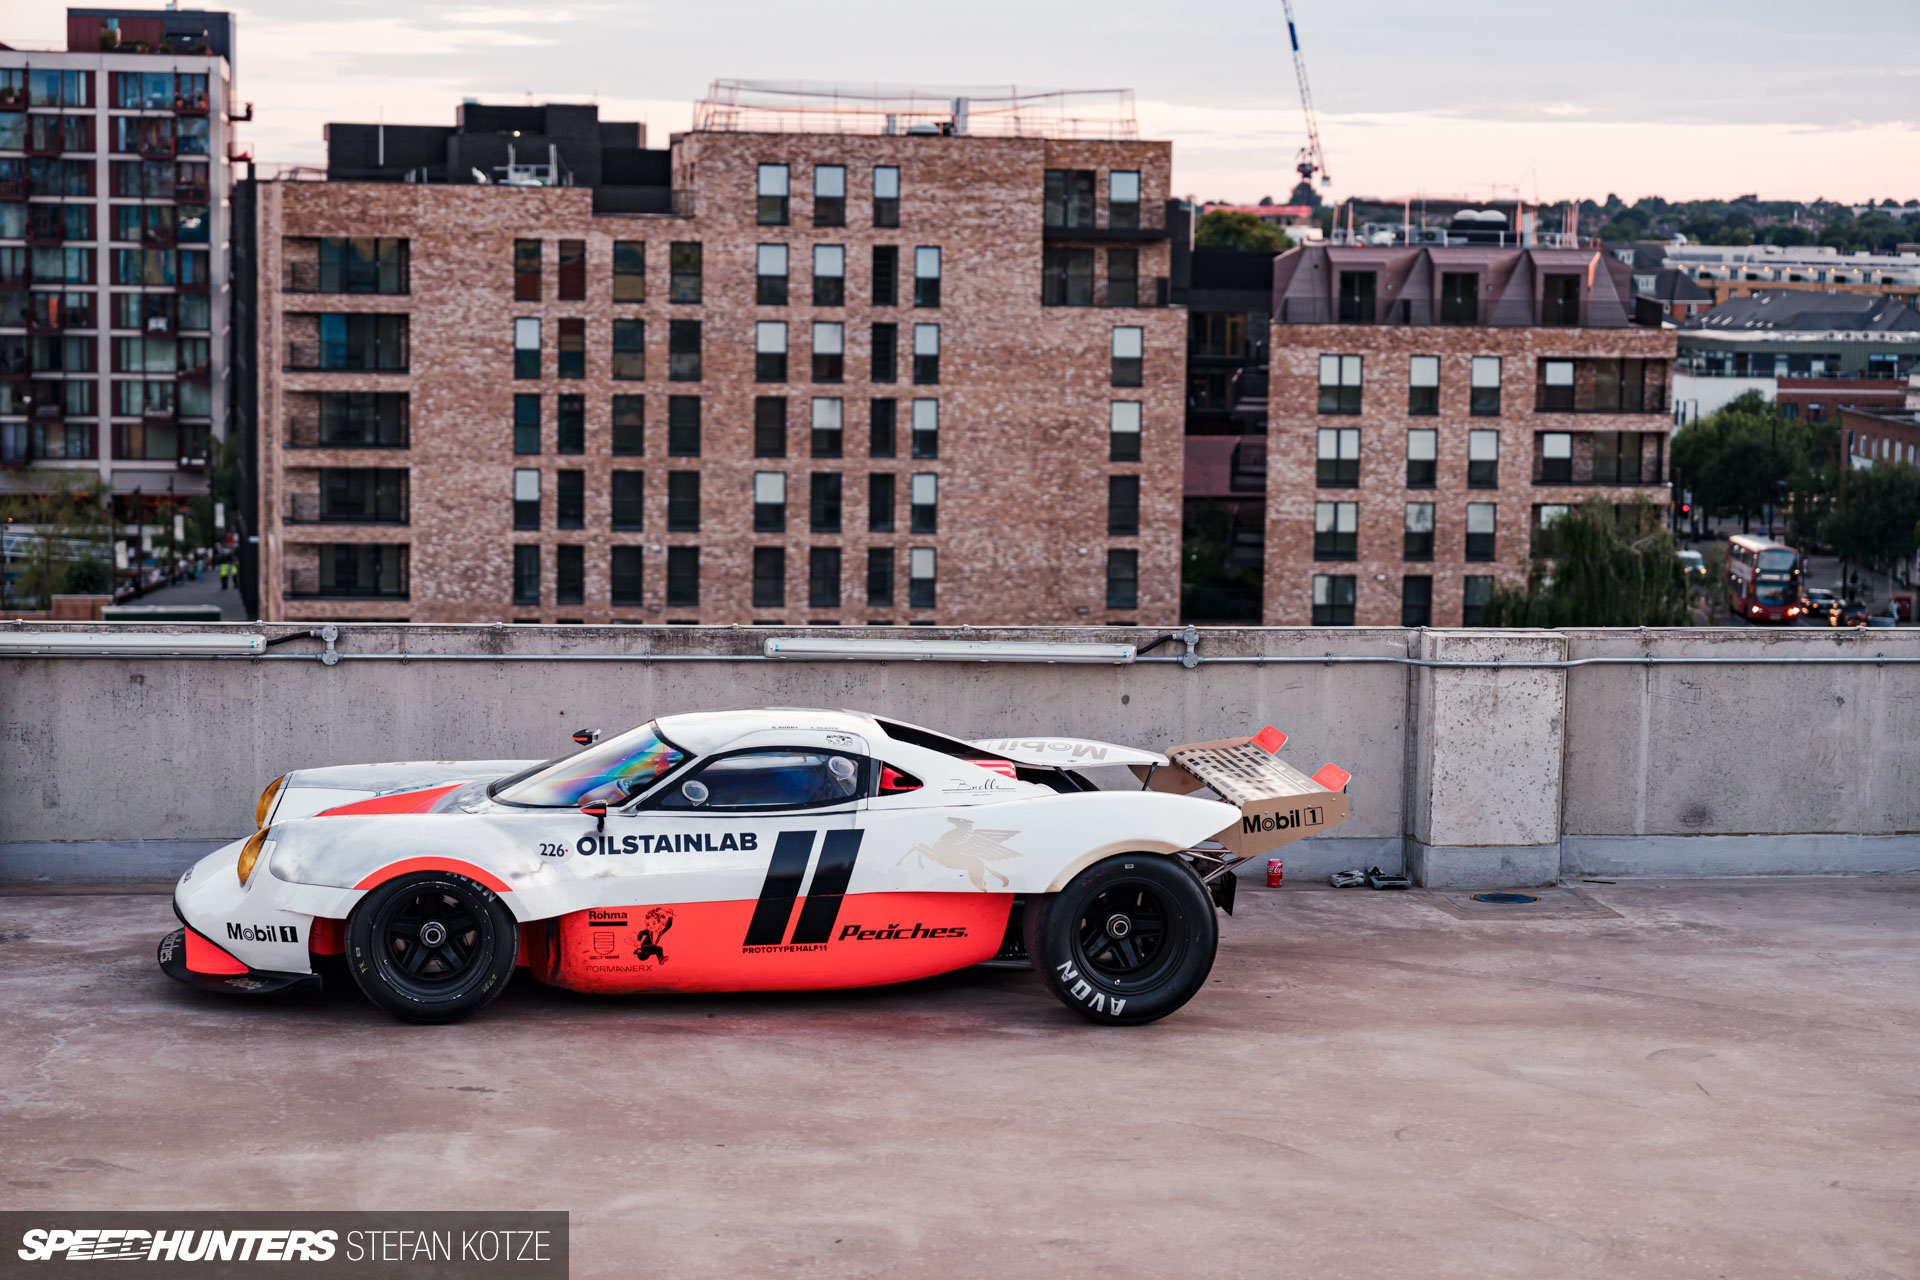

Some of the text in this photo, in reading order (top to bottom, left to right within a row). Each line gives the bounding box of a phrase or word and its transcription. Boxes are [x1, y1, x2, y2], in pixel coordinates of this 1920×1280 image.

[998, 740, 1108, 761] Mobil
[1242, 809, 1301, 834] Mobil
[576, 832, 758, 856] OILSTAINLAB
[226, 922, 278, 943] Mobil
[742, 946, 795, 954] PROTOTYPE
[1056, 959, 1127, 1016] AVON
